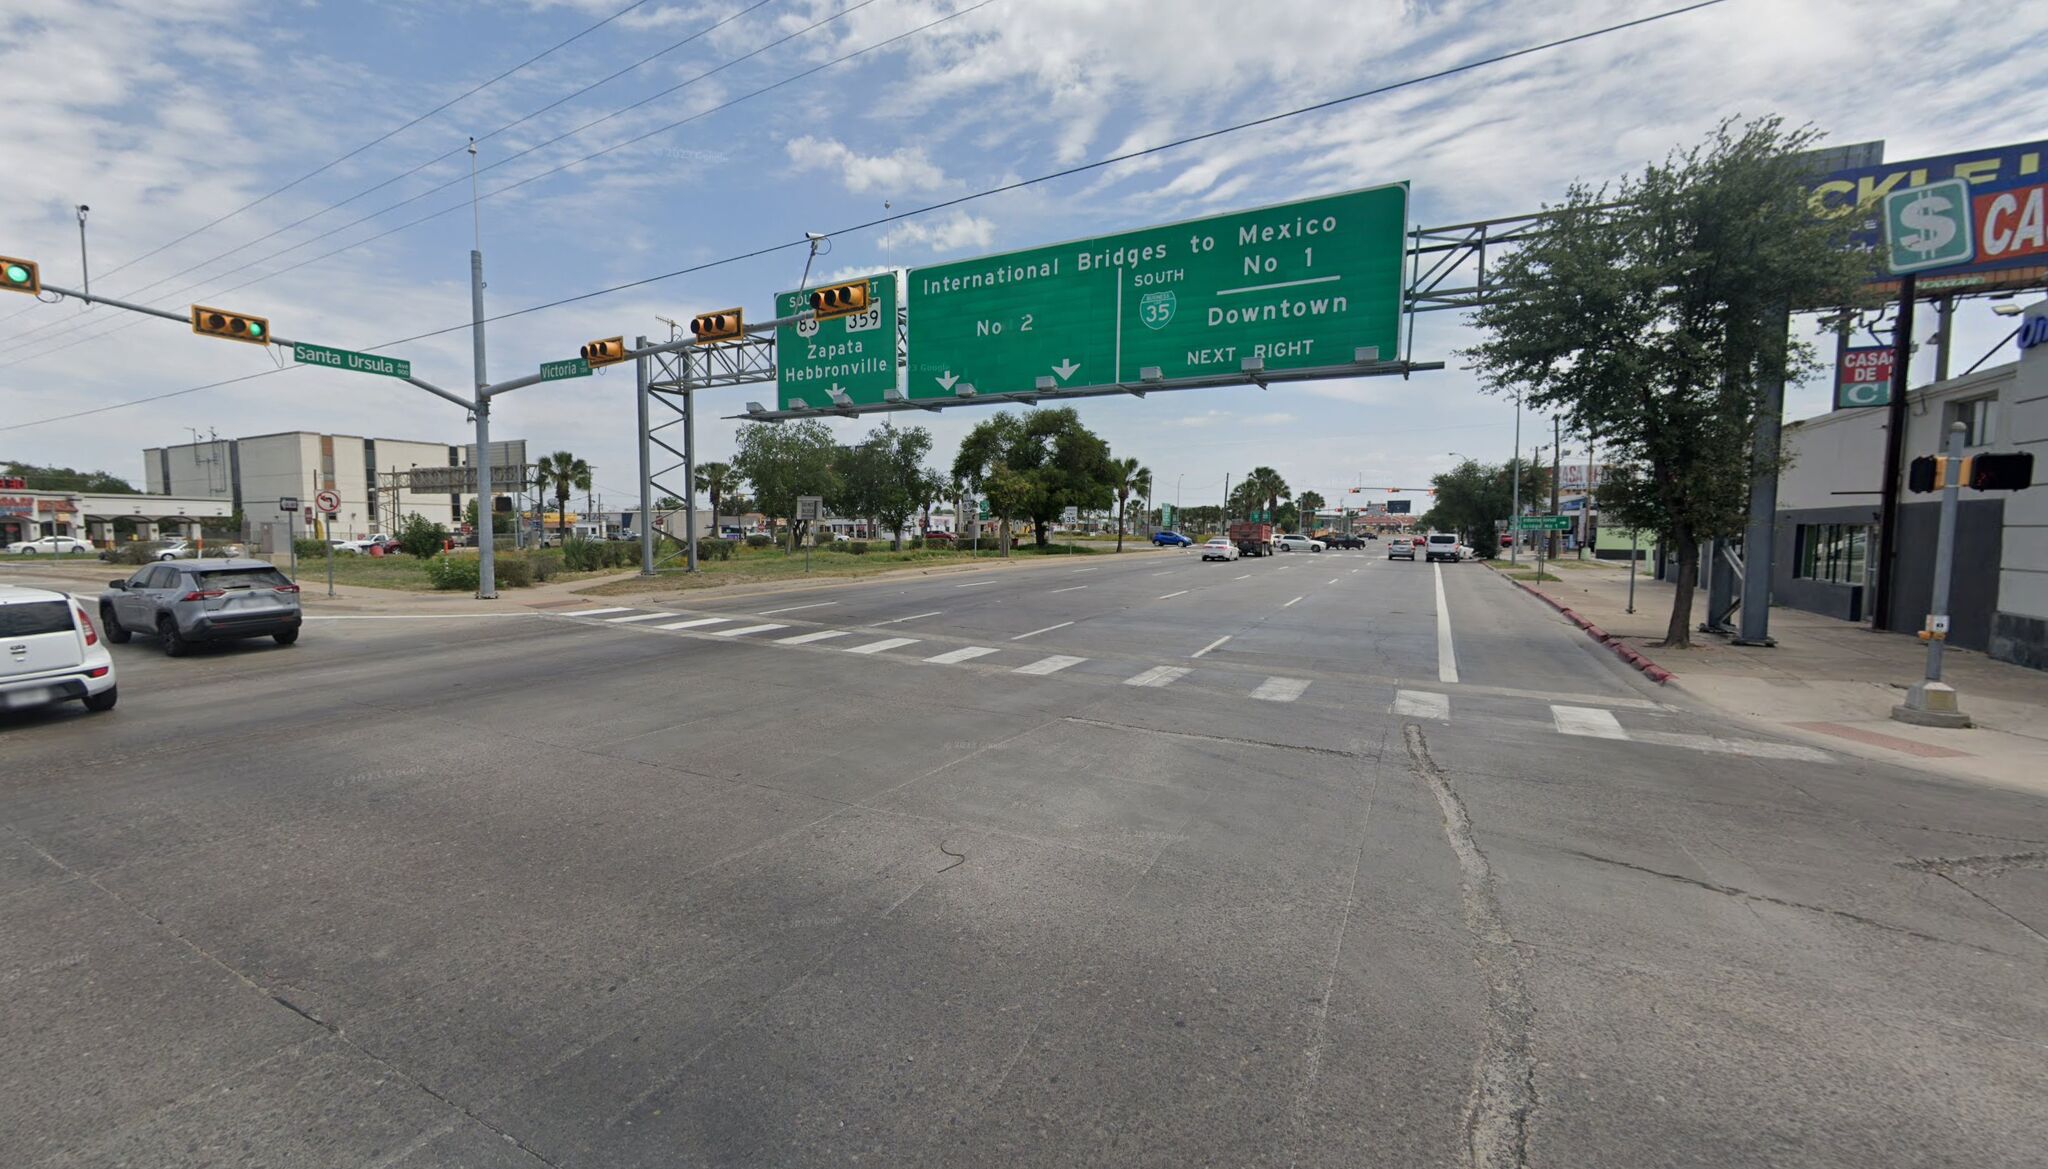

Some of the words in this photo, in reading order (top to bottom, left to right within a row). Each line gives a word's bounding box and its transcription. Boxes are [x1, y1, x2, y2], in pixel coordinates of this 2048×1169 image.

[924, 258, 1058, 295] International
[1078, 243, 1167, 269] Bridges
[1190, 235, 1215, 254] to
[1239, 216, 1337, 246] Mexico
[1244, 255, 1278, 275] No
[1304, 247, 1312, 267] 1
[1134, 268, 1184, 287] SOUTH
[849, 310, 879, 329] 359
[1146, 303, 1170, 322] 35
[1208, 296, 1348, 326] Downtown
[977, 320, 1002, 337] No
[1020, 314, 1033, 332] 2
[296, 346, 342, 365] Santa
[348, 354, 394, 373] Ursula
[807, 339, 863, 360] Zapata
[1187, 347, 1236, 365] NEXT
[1254, 339, 1315, 358] RIGHT
[1844, 352, 1889, 367] CASA
[541, 361, 577, 378] Victoria
[785, 358, 888, 383] Hebbronville
[1854, 367, 1877, 381] DE
